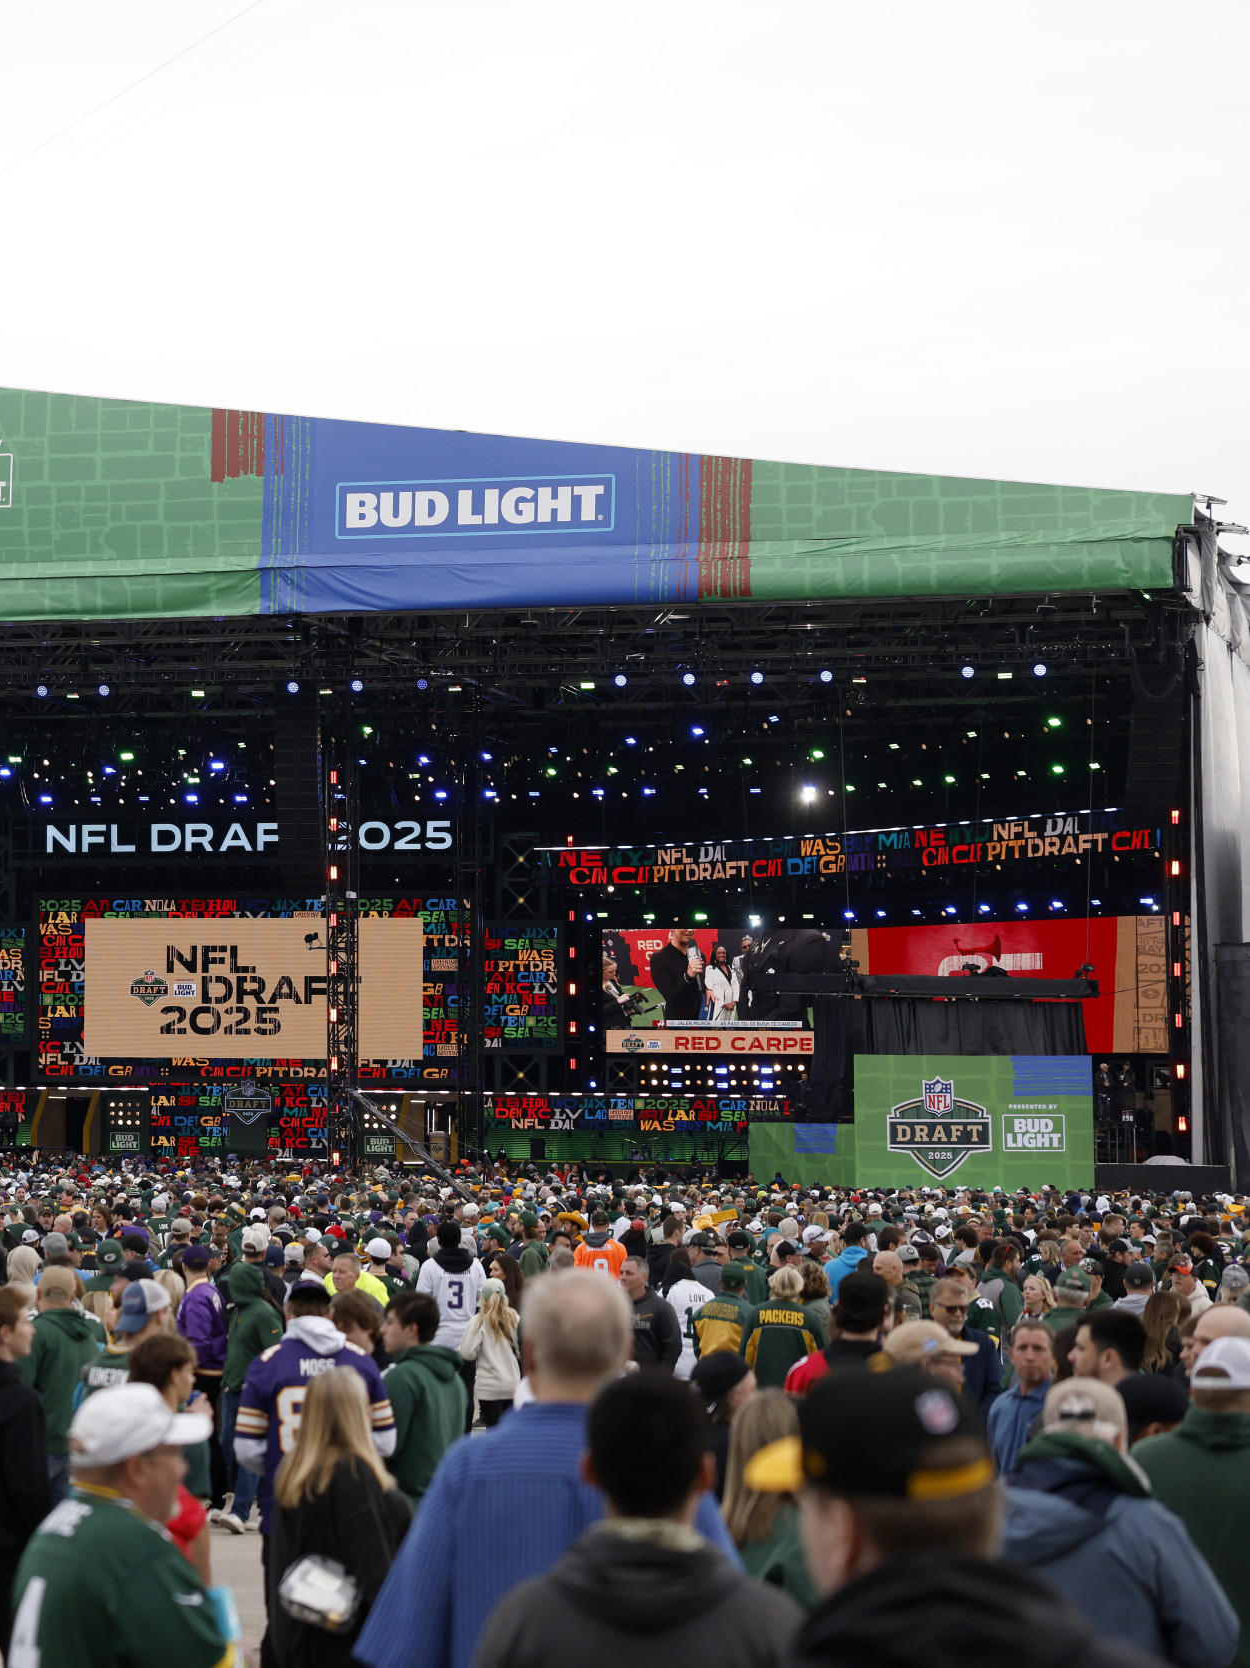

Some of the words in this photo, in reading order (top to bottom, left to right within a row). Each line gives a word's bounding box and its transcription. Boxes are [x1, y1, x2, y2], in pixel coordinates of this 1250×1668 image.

[346, 490, 450, 529] BUD
[457, 485, 605, 525] LIGHT
[46, 824, 136, 853] NFL
[150, 823, 280, 852] DRAF
[915, 829, 946, 847] NE
[993, 820, 1038, 841] NFL
[1044, 816, 1080, 837] DAL
[558, 850, 603, 867] NE
[658, 848, 694, 866] NFL
[699, 845, 727, 863] DAL
[800, 838, 842, 857] WAS
[922, 845, 949, 867] CIN
[986, 839, 1026, 860] PIT
[1027, 832, 1109, 858] DRAFT
[568, 867, 608, 885] CIN
[653, 864, 685, 883] PIT
[685, 860, 749, 882] DRAFT
[752, 858, 783, 878] CHI
[787, 856, 818, 876] DET
[819, 855, 846, 874] GB
[113, 900, 143, 911] CAR
[426, 899, 458, 911] CAR
[48, 911, 78, 923] LAR
[417, 910, 446, 923] SEA
[504, 938, 532, 950] SEA
[637, 940, 663, 951] RED
[54, 946, 83, 959] HOU
[518, 949, 555, 961] WAS
[166, 945, 257, 974] NFL
[497, 960, 530, 972] PIT
[517, 971, 548, 983] CAR
[132, 986, 166, 994] DRAFT
[174, 990, 196, 998] LIGHT
[201, 975, 362, 1005] DRAF
[504, 982, 531, 994] KC
[491, 993, 519, 1005] MIA
[521, 993, 548, 1005] NE
[47, 1005, 77, 1018] LAR
[159, 1005, 282, 1036] 2025
[430, 1019, 459, 1032] NE
[503, 1026, 531, 1038] SEA
[674, 1036, 722, 1051] RED
[73, 1053, 101, 1066] DAL
[255, 1066, 290, 1078] PIT
[358, 1067, 388, 1079] CHI
[391, 1067, 424, 1079] DET
[151, 1095, 176, 1107] LAR
[199, 1096, 223, 1107] SEA
[284, 1096, 309, 1107] KC
[228, 1100, 268, 1109] DRAFT
[609, 1098, 634, 1109] TEN
[645, 1098, 690, 1110] 2025
[718, 1099, 747, 1111] CAR
[927, 1094, 950, 1111] NFL
[174, 1115, 199, 1127] DET
[495, 1107, 522, 1119] DEN
[526, 1107, 552, 1119] KC
[553, 1108, 584, 1120] LV
[584, 1108, 607, 1120] LAC
[667, 1109, 696, 1121] LAR
[720, 1110, 747, 1122] SEA
[511, 1118, 545, 1130] NFL
[549, 1119, 575, 1130] DAL
[640, 1120, 676, 1131] WAS
[1013, 1118, 1054, 1133] BUD
[115, 1133, 135, 1142] BUD
[896, 1124, 983, 1142] DRAFT
[111, 1141, 138, 1150] LIGHT
[151, 1136, 176, 1147] LAR
[199, 1136, 223, 1147] SEA
[284, 1137, 309, 1148] KC
[1006, 1132, 1062, 1148] LIGHT
[366, 1144, 394, 1153] LIGHT
[928, 1152, 953, 1160] 2025
[447, 1280, 464, 1309] 3
[689, 1293, 705, 1303] LOVE
[759, 1309, 805, 1327] PACKERS
[300, 1358, 336, 1378] MOSS
